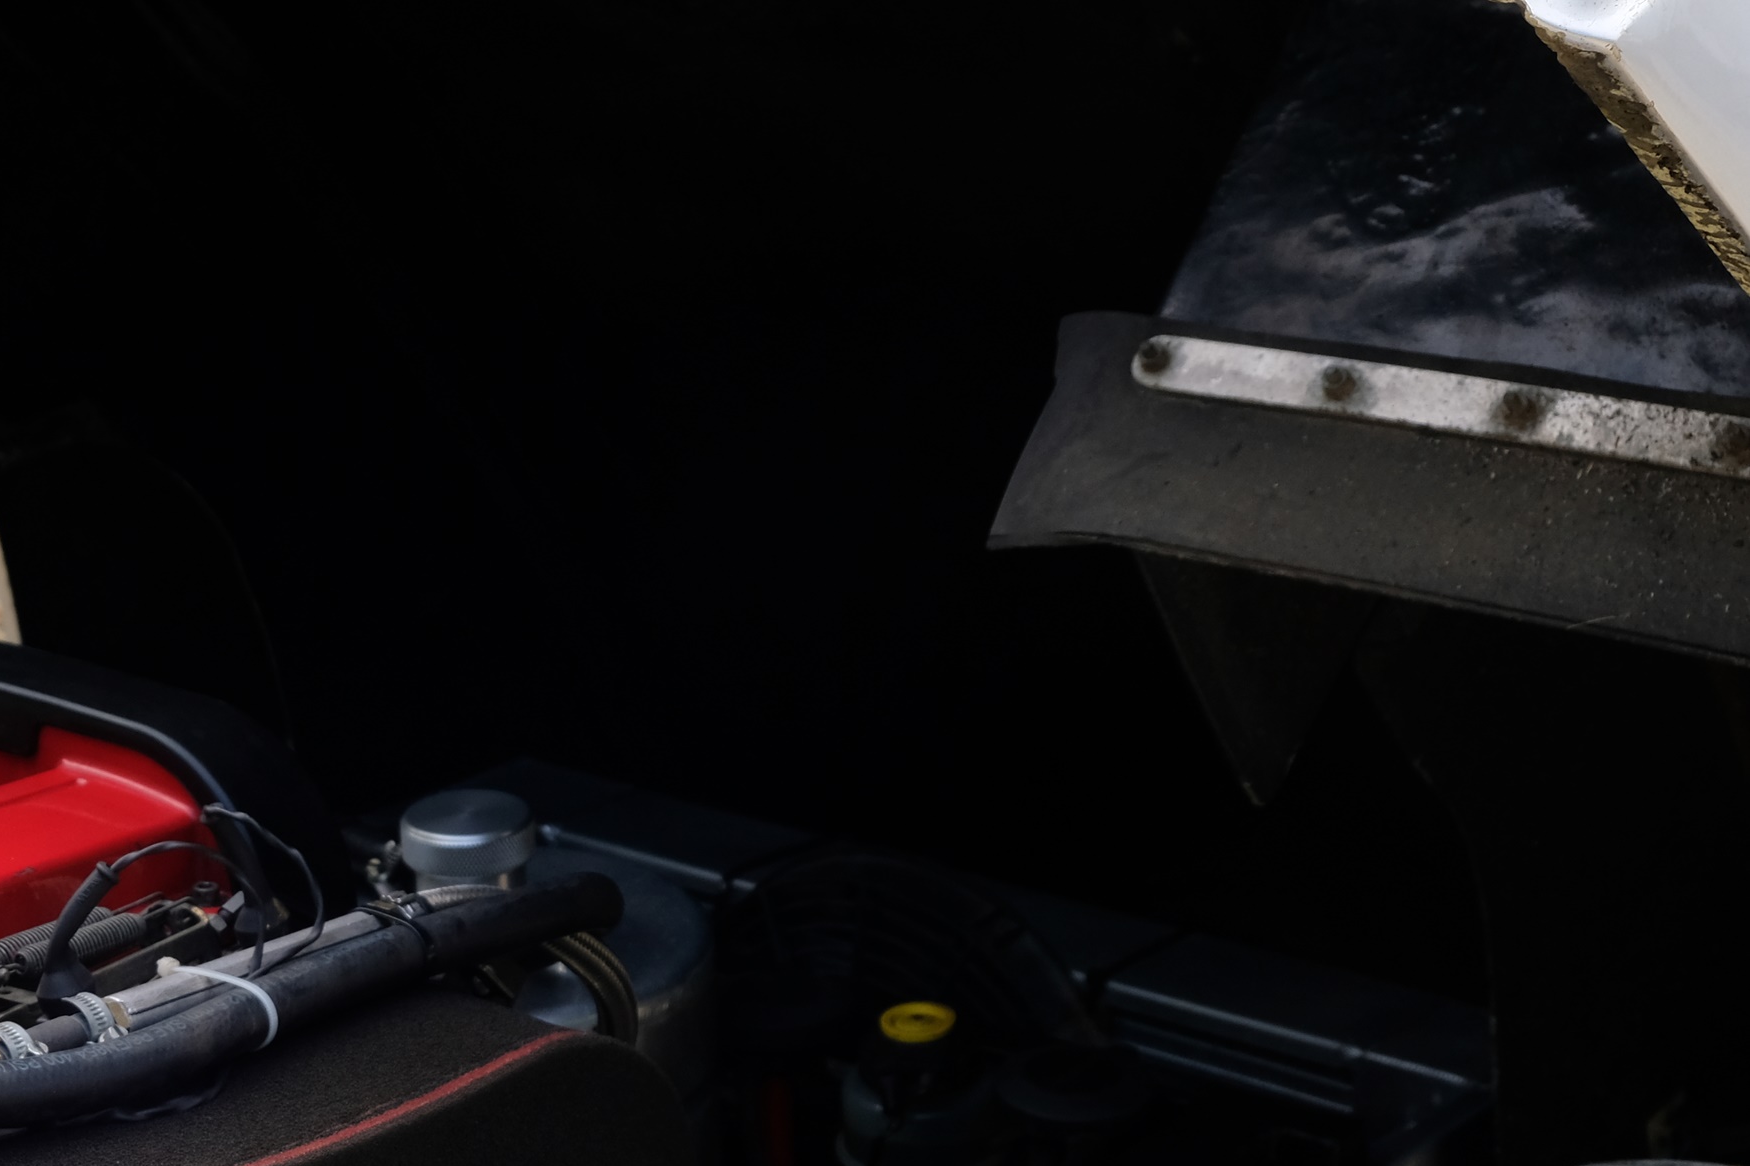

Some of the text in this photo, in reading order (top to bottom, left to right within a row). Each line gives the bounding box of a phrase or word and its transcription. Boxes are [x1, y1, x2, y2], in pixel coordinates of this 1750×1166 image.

[150, 1014, 187, 1041] SAE
[7, 1054, 42, 1074] PSI
[40, 1050, 72, 1068] 400
